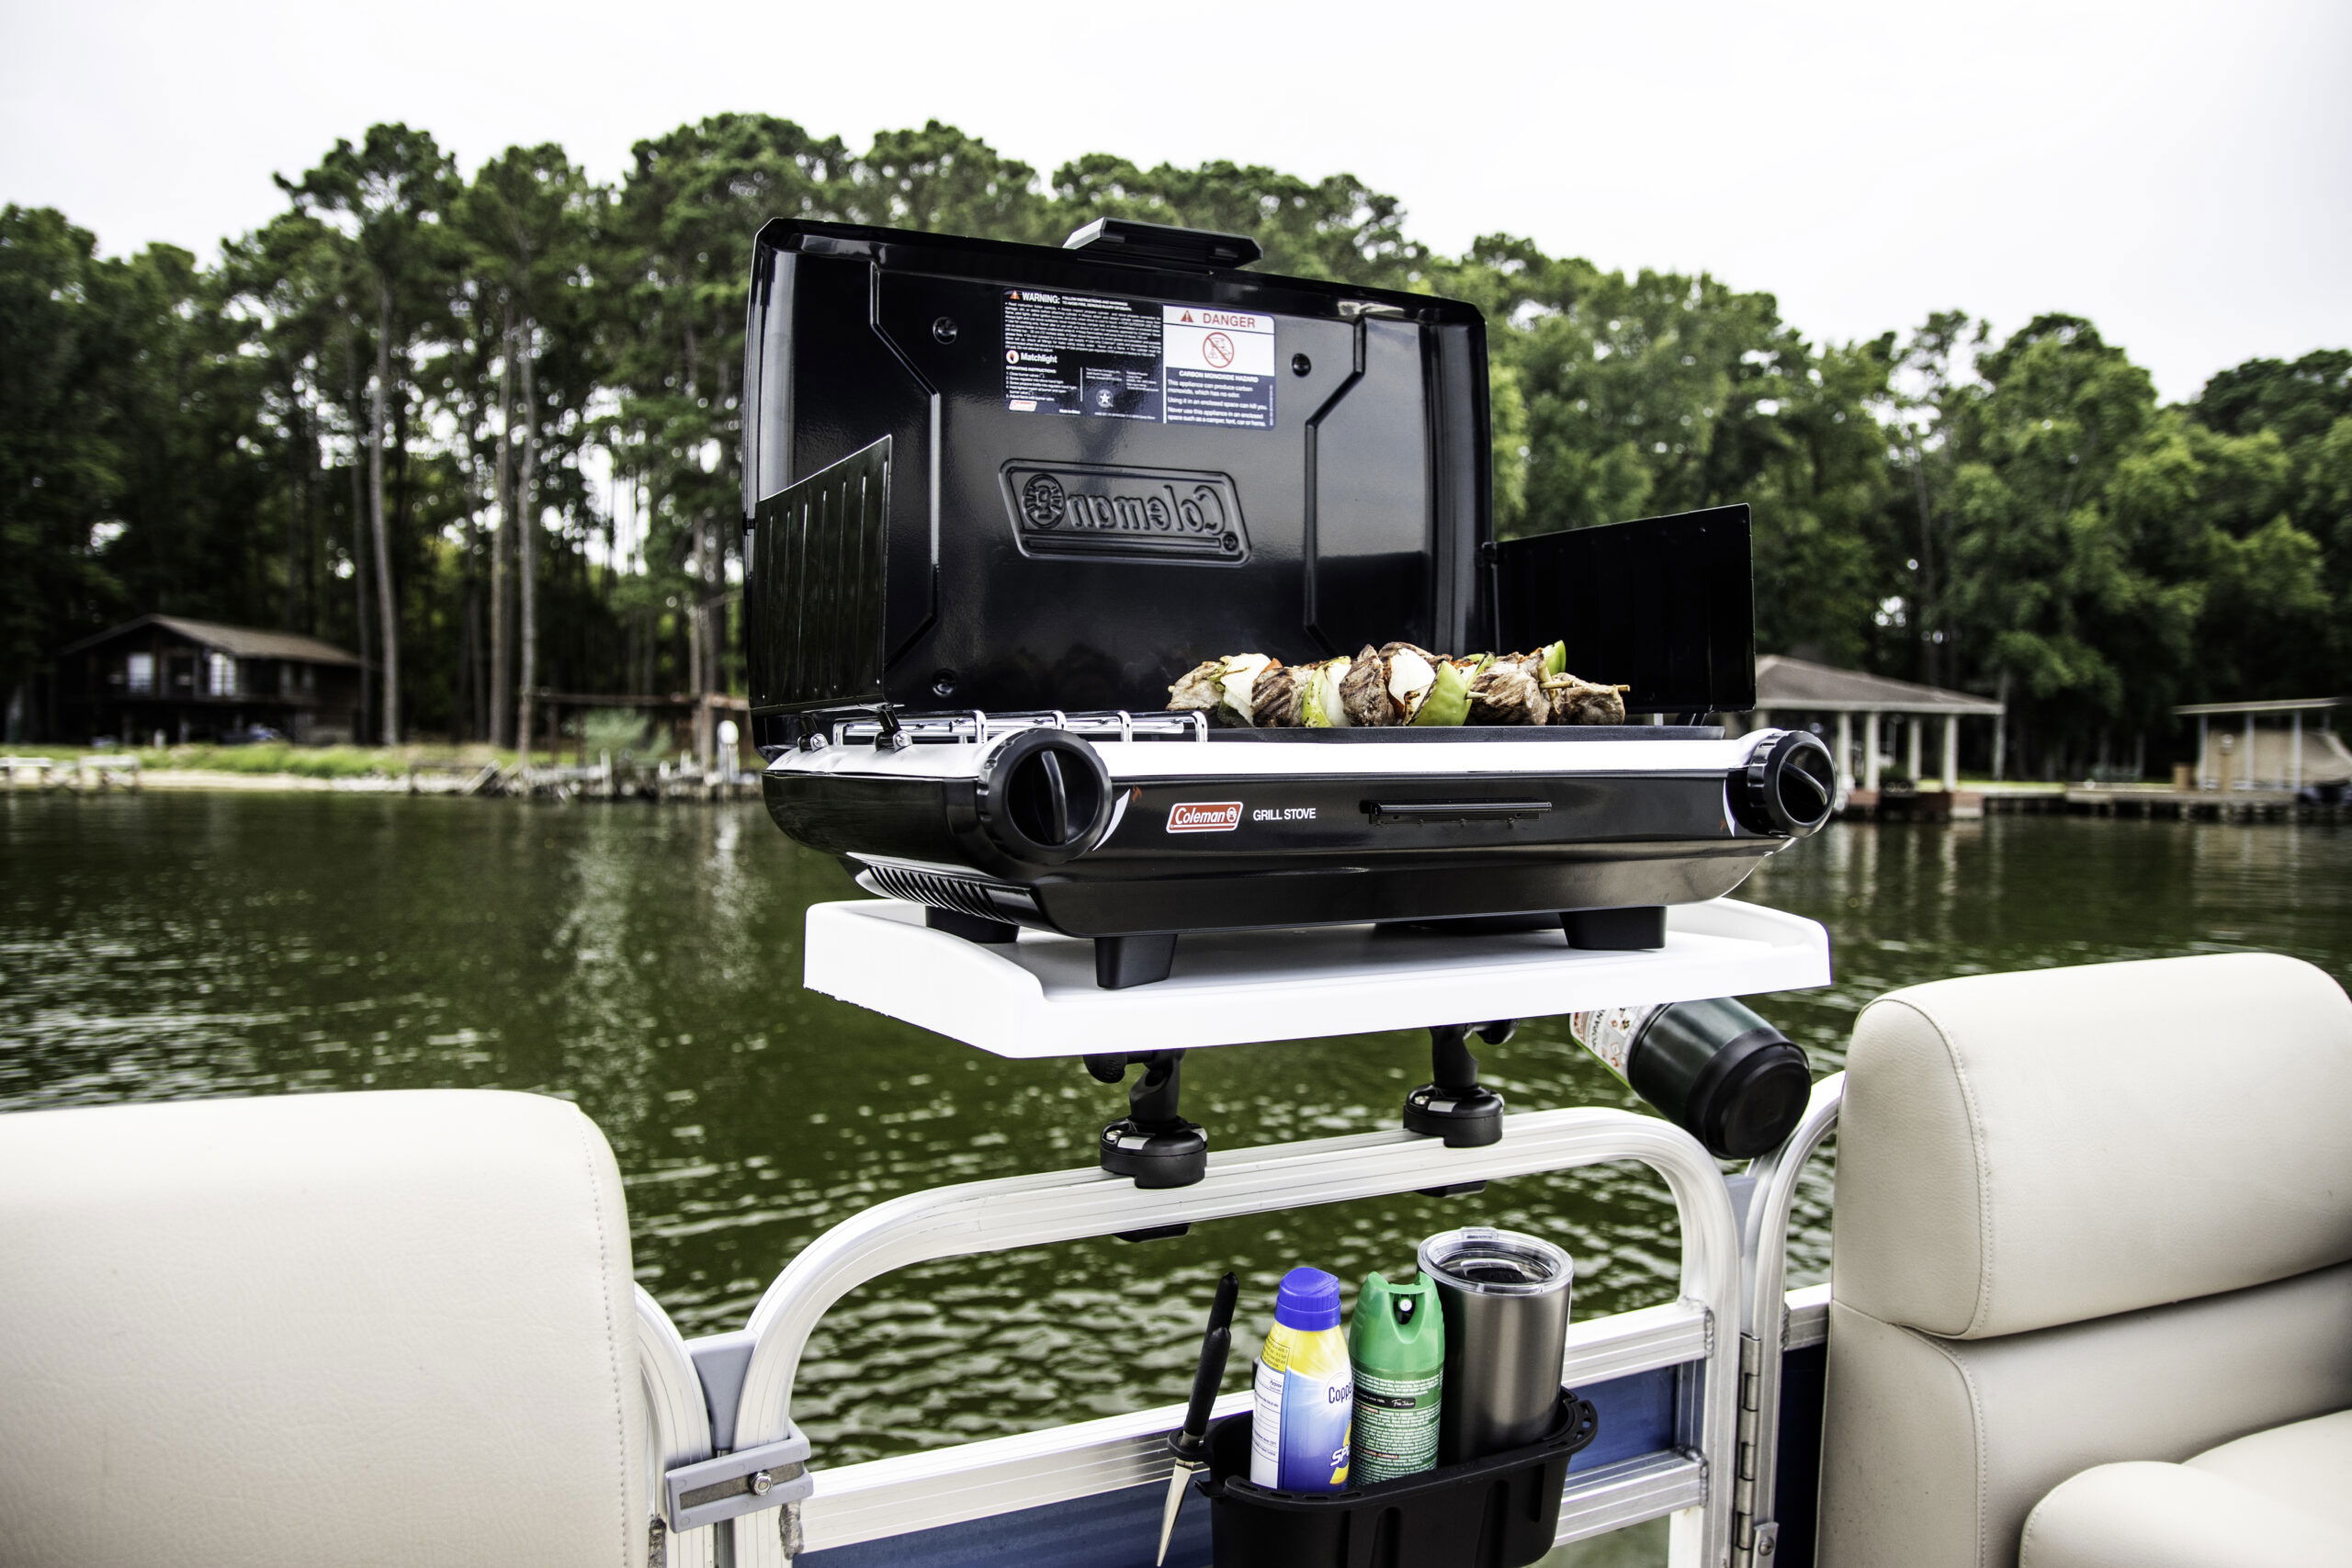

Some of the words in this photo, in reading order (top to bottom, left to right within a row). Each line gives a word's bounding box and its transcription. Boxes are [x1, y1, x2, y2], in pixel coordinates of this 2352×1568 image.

[1022, 291, 1060, 304] WARNING:
[1203, 312, 1256, 328] DANGER
[1021, 352, 1057, 364] Matchlight
[1175, 807, 1225, 824] Coleman
[1252, 809, 1283, 821] GRILL
[1284, 808, 1317, 819] STOVE
